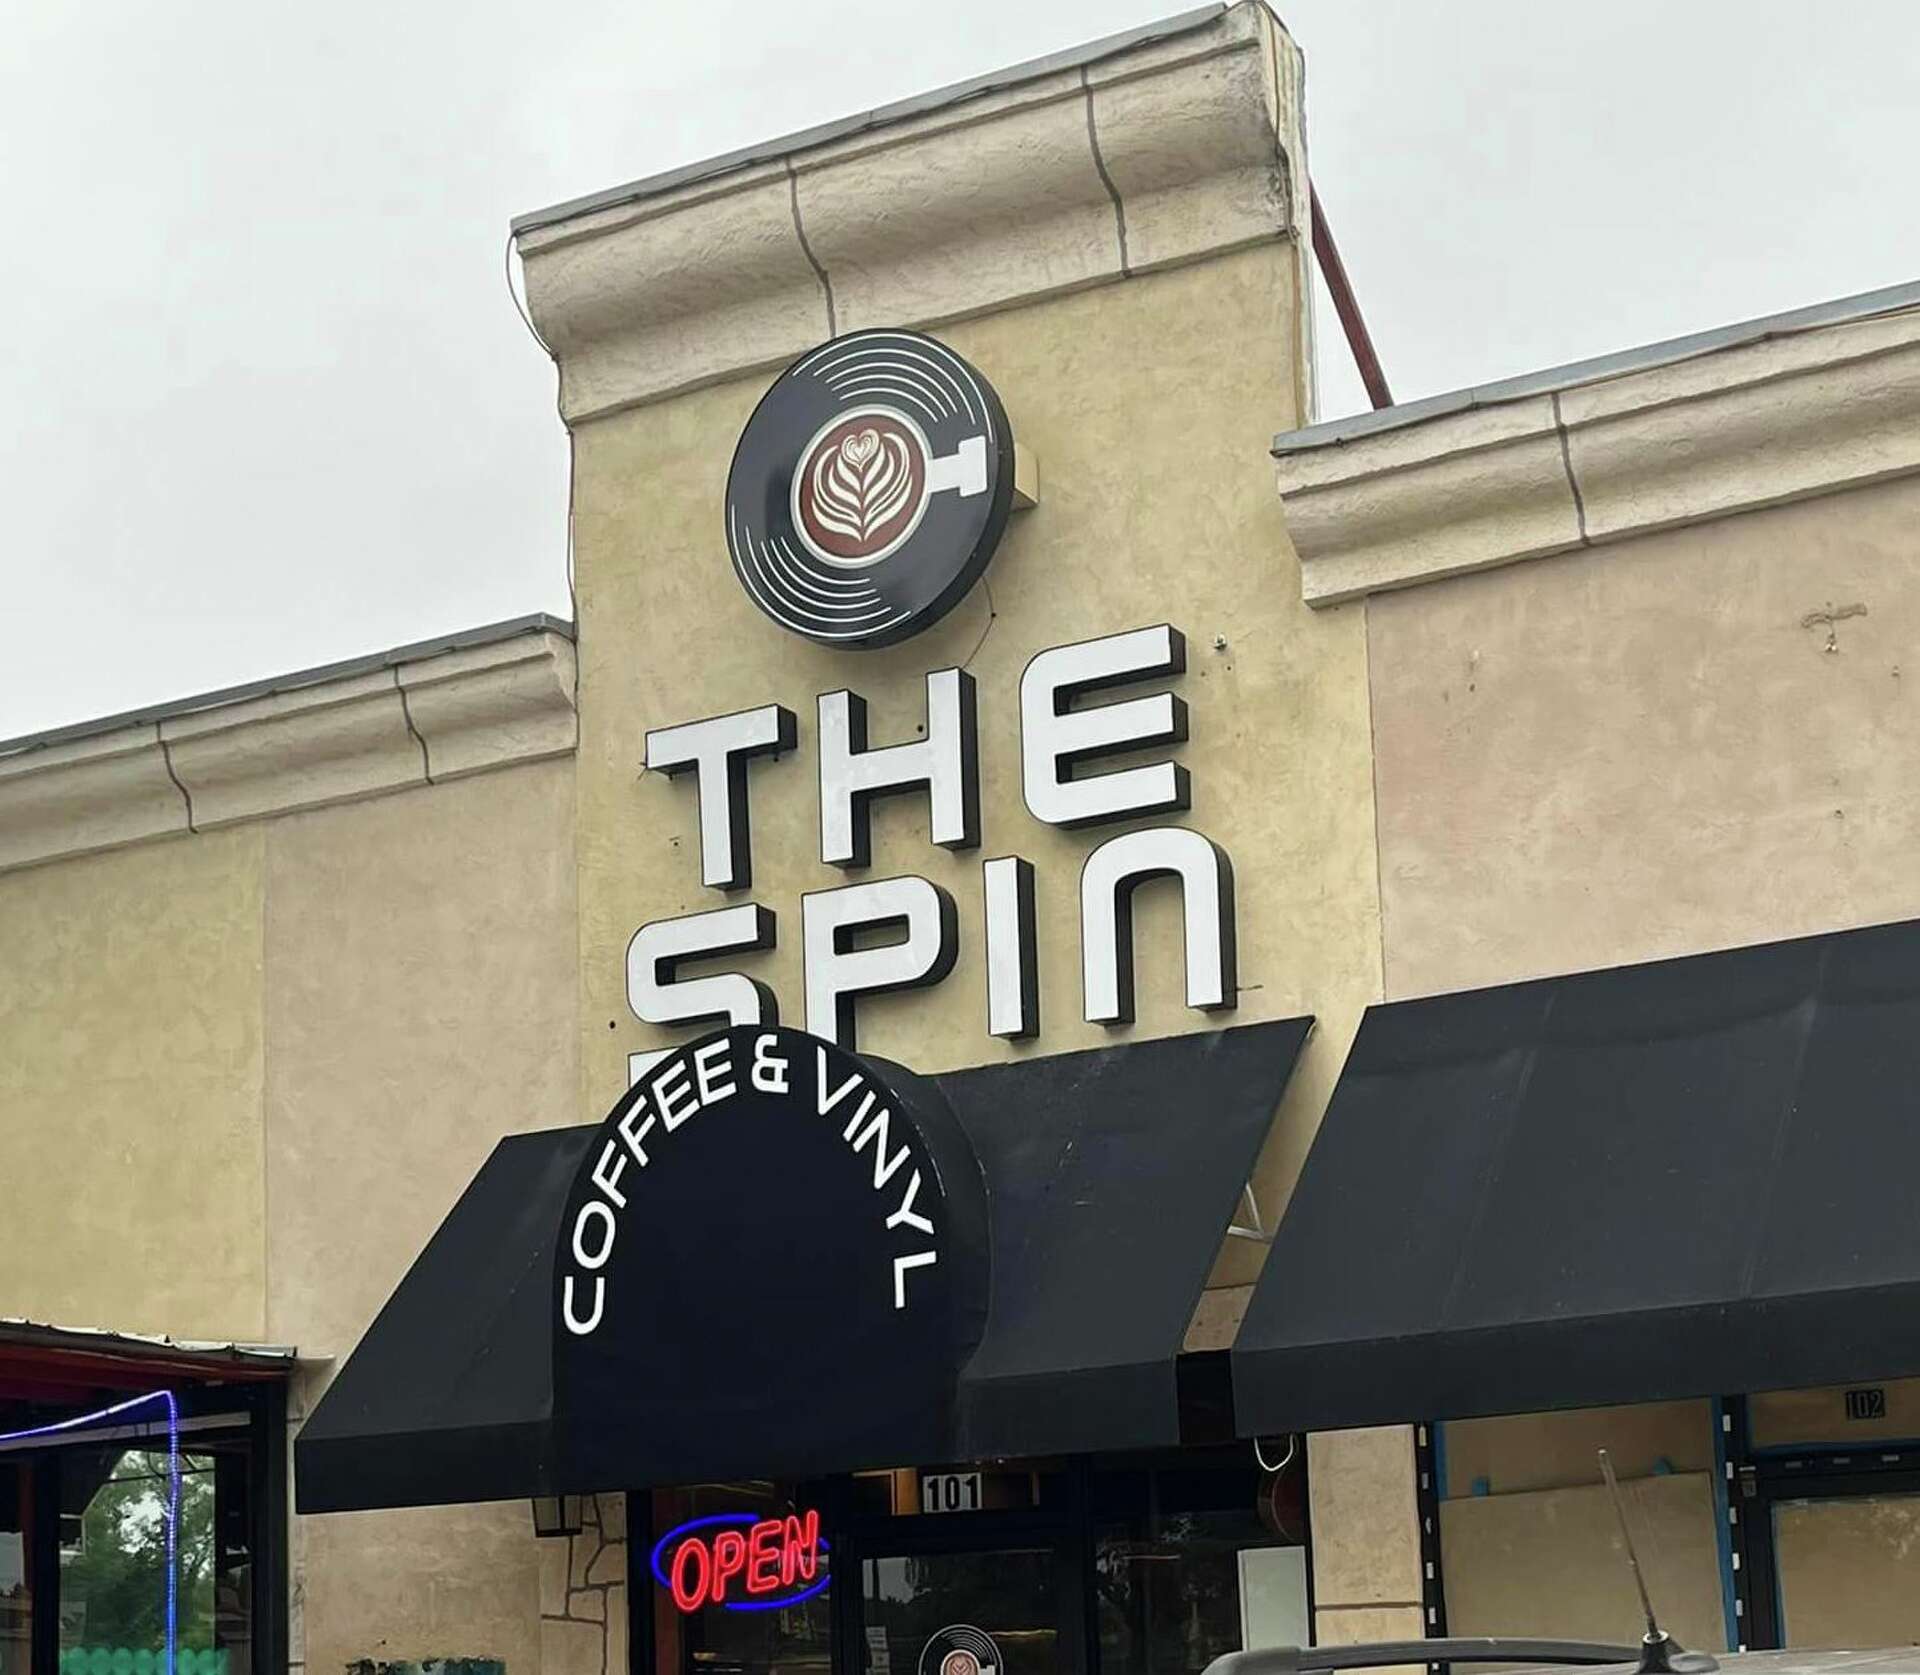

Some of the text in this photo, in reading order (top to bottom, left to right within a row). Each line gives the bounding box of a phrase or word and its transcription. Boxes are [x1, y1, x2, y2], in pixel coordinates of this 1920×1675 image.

[645, 624, 1190, 890] THE
[626, 826, 1238, 1086] SPIN
[563, 1034, 937, 1335] COFFEE & VINYL
[927, 1475, 979, 1511] 101
[1846, 1391, 1882, 1418] 102
[671, 1509, 819, 1613] OPEN
